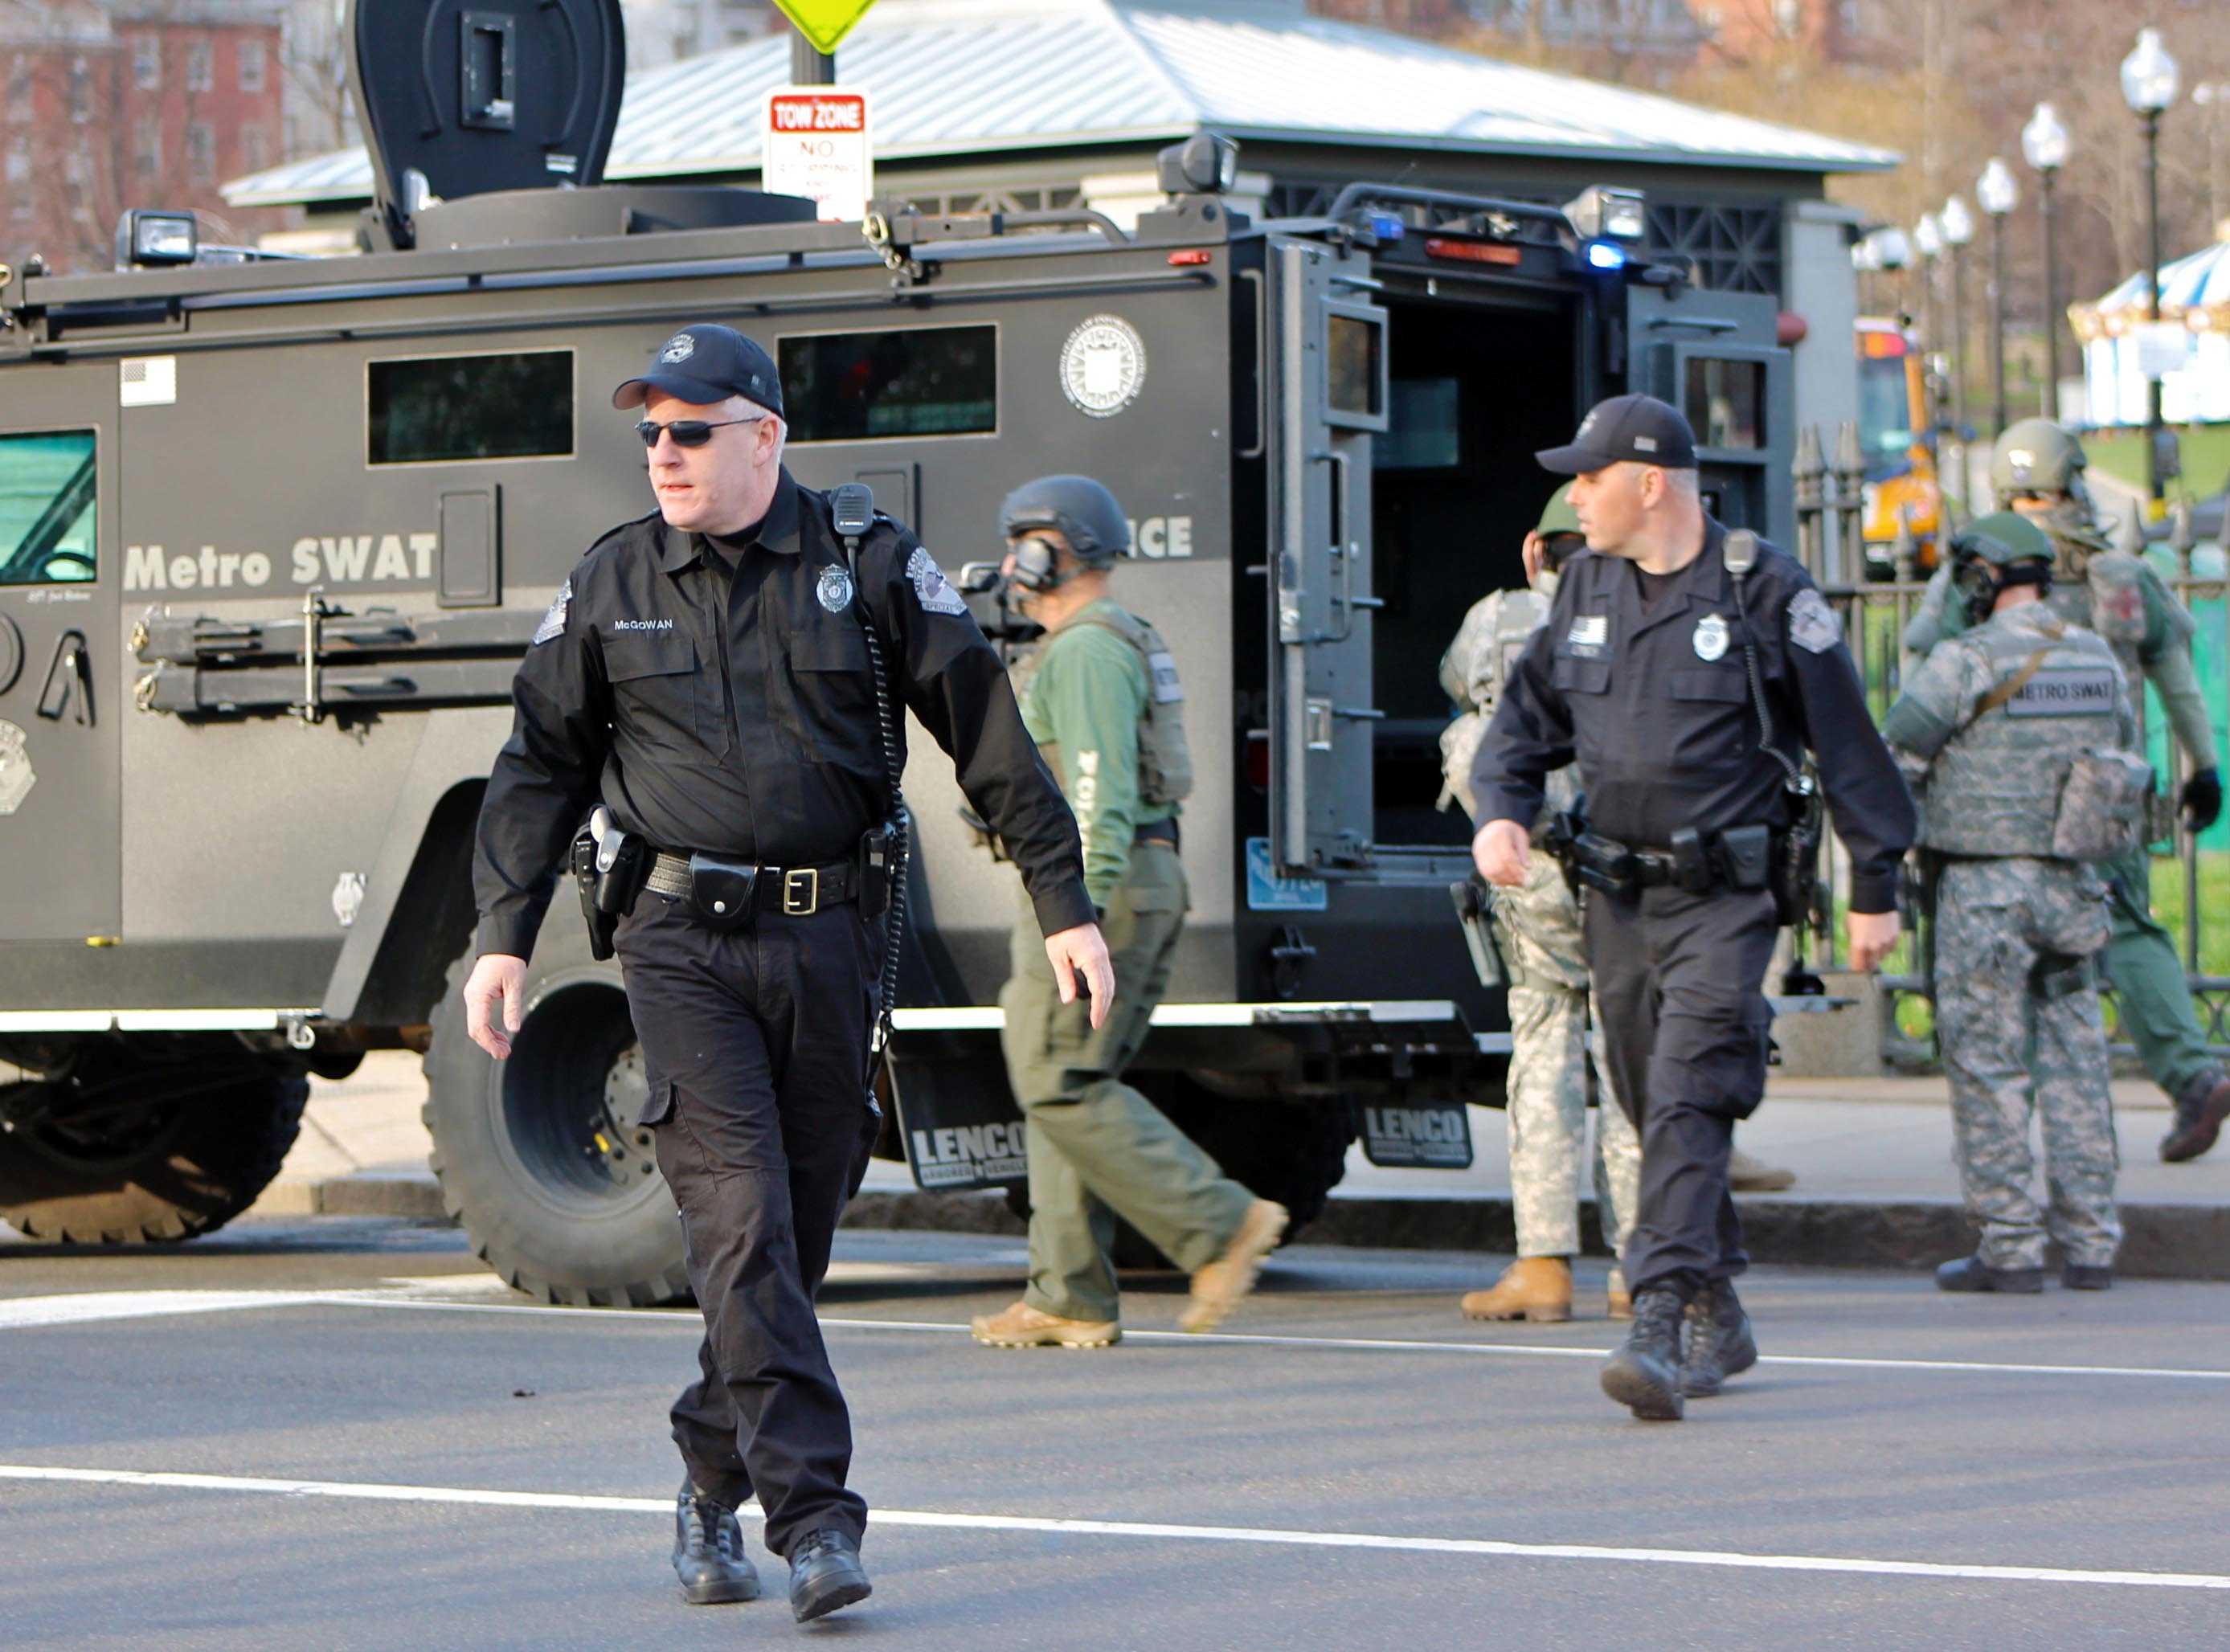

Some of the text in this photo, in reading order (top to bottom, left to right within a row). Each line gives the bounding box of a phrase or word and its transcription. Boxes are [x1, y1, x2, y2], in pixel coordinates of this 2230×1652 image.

[775, 102, 861, 129] TOW ZONE
[800, 140, 834, 157] NO
[1126, 516, 1193, 558] ICE
[124, 533, 436, 591] Metro SWAT
[2071, 682, 2109, 699] SWAT
[1365, 1107, 1464, 1142] LENCO
[912, 1122, 1028, 1164] LENCO
